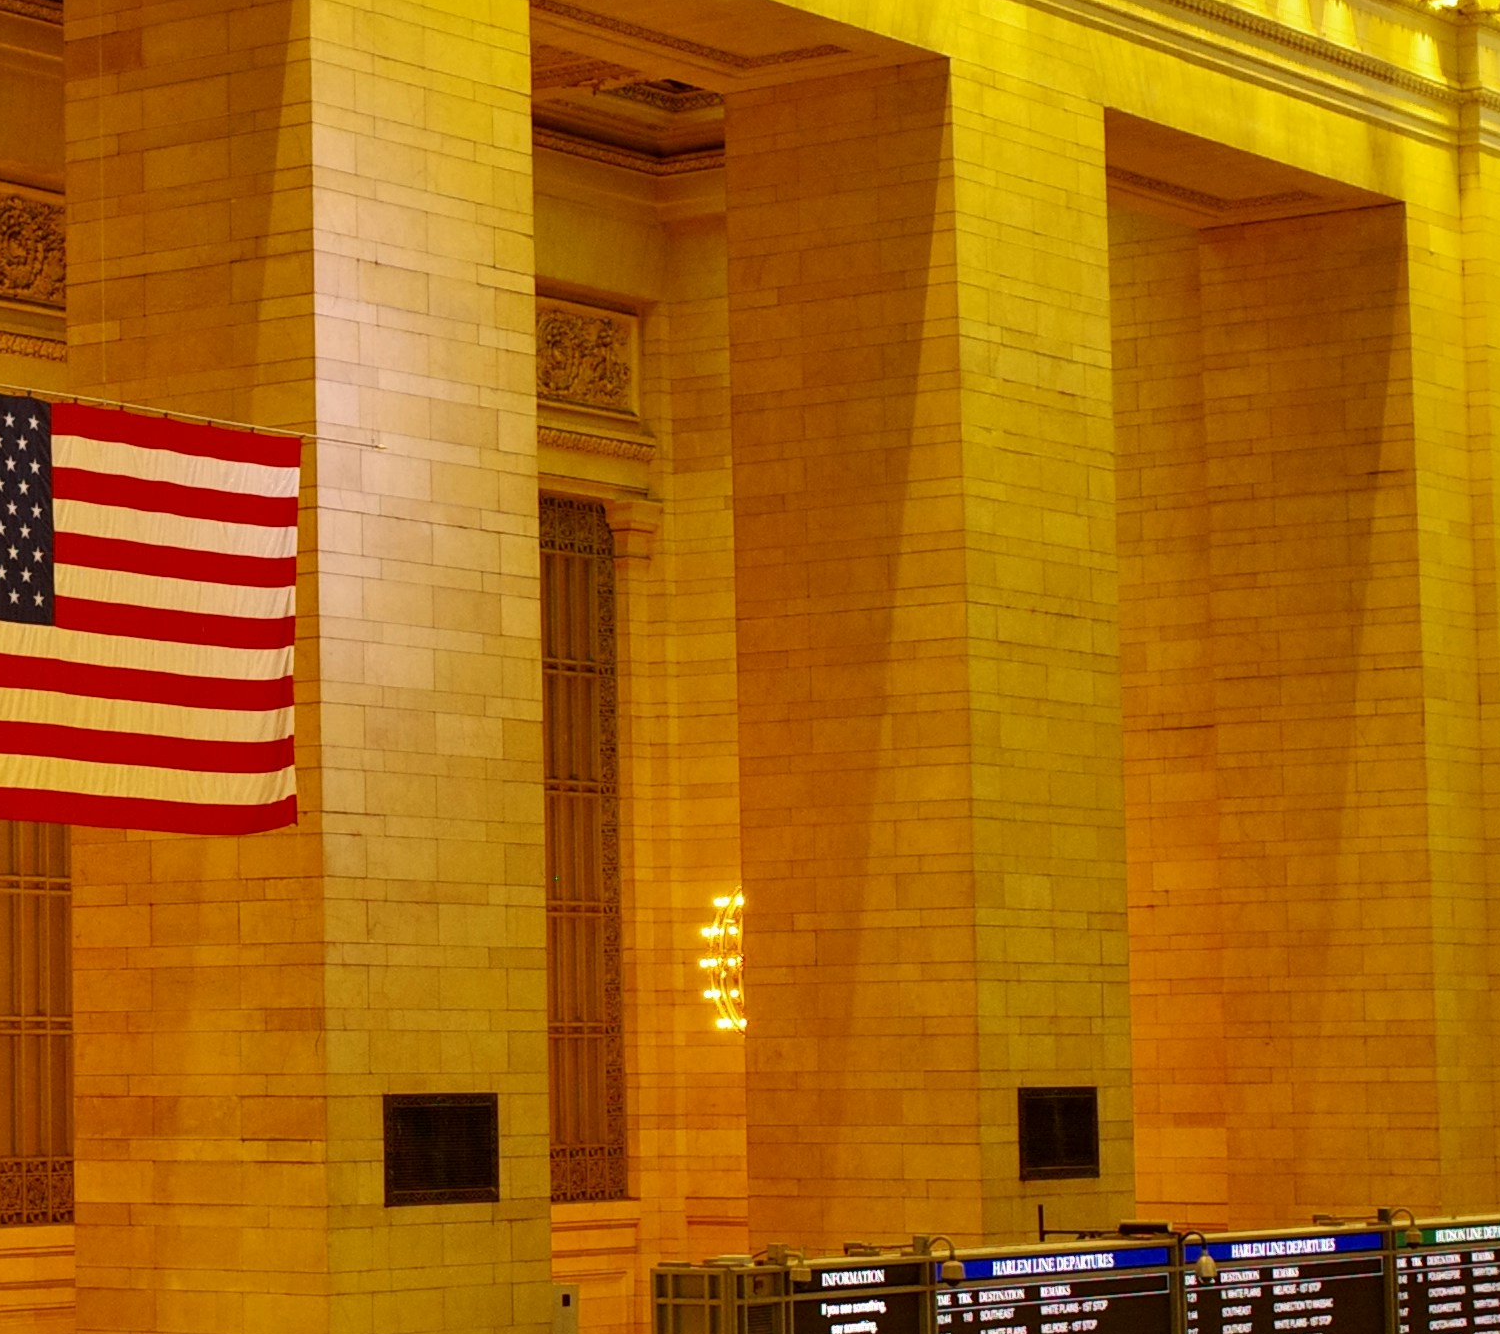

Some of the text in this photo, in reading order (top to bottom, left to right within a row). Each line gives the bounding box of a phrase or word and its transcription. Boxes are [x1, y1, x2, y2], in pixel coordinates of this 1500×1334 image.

[992, 1253, 1114, 1277] HARLEM LINE DEPARTURES
[821, 1269, 885, 1287] INFORMATION
